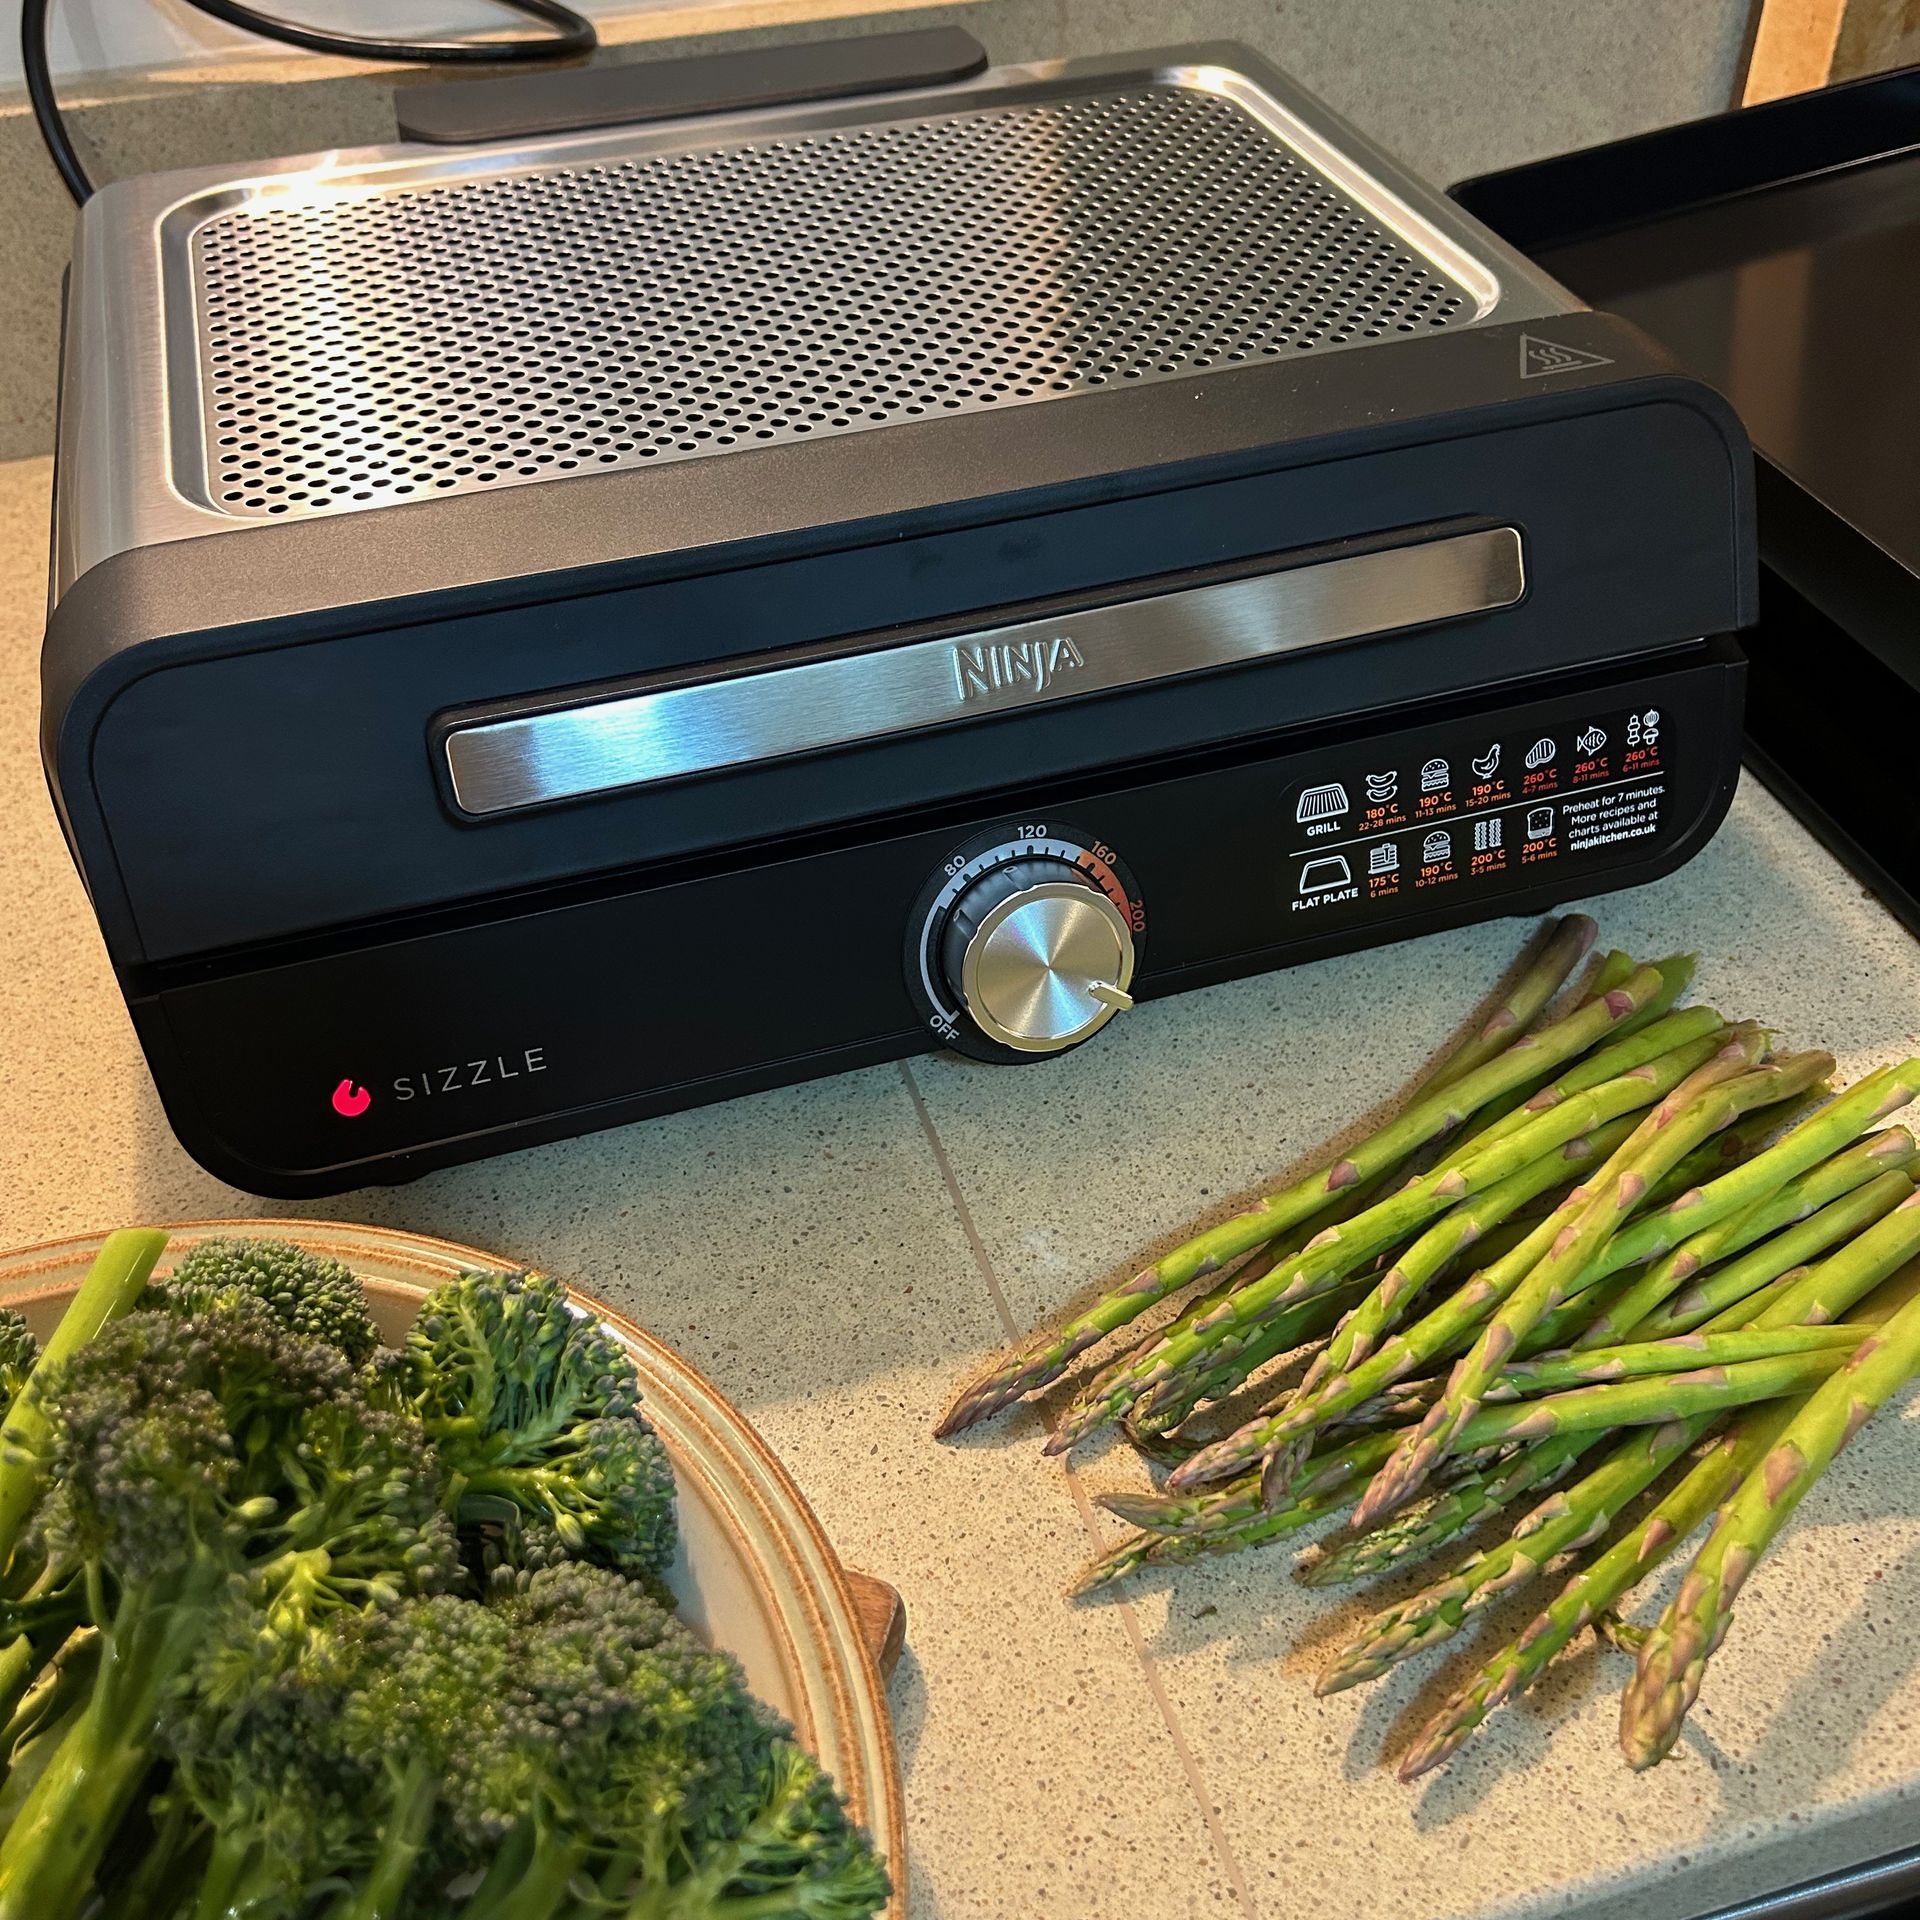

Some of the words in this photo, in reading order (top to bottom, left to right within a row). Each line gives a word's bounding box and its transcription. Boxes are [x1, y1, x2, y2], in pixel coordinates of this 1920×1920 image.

[952, 636, 1084, 701] NINJA
[1640, 758, 1661, 770] mins
[1589, 769, 1610, 781] mins
[1521, 784, 1537, 795] 4-7
[1538, 781, 1559, 793] mins
[1465, 795, 1489, 808] 15-20
[1490, 790, 1512, 803] mins
[1562, 799, 1600, 815] Preheat
[1601, 795, 1617, 806] for
[1618, 793, 1624, 802] 7
[1625, 785, 1666, 802] minutes.
[1415, 808, 1435, 819] 11-13
[1436, 803, 1457, 816] mins
[1571, 814, 1597, 826] More
[1599, 805, 1635, 821] recipes
[1637, 798, 1657, 810] and
[1017, 824, 1047, 839] 120
[1306, 821, 1341, 837] GRILL
[1358, 819, 1384, 831] 22-28
[1385, 814, 1407, 826] mins
[1568, 824, 1600, 839] charts
[1602, 814, 1646, 831] available
[1648, 810, 1658, 820] at
[1570, 824, 1656, 851] ninjakitchen.co.uk
[1091, 840, 1117, 866] 160
[1521, 853, 1536, 864] 5-6
[1537, 849, 1558, 861] mins
[944, 855, 966, 876] 80
[1470, 865, 1485, 876] 3-5
[1486, 861, 1507, 872] mins
[1415, 877, 1437, 888] 10-12
[1438, 872, 1459, 884] mins
[1292, 896, 1320, 911] FLAT
[1323, 887, 1359, 904] PLATE
[1370, 889, 1376, 898] 6
[1378, 886, 1399, 897] mins
[1130, 899, 1146, 932] 200
[929, 1014, 960, 1042] OFF
[393, 1047, 547, 1101] SIZZLE
